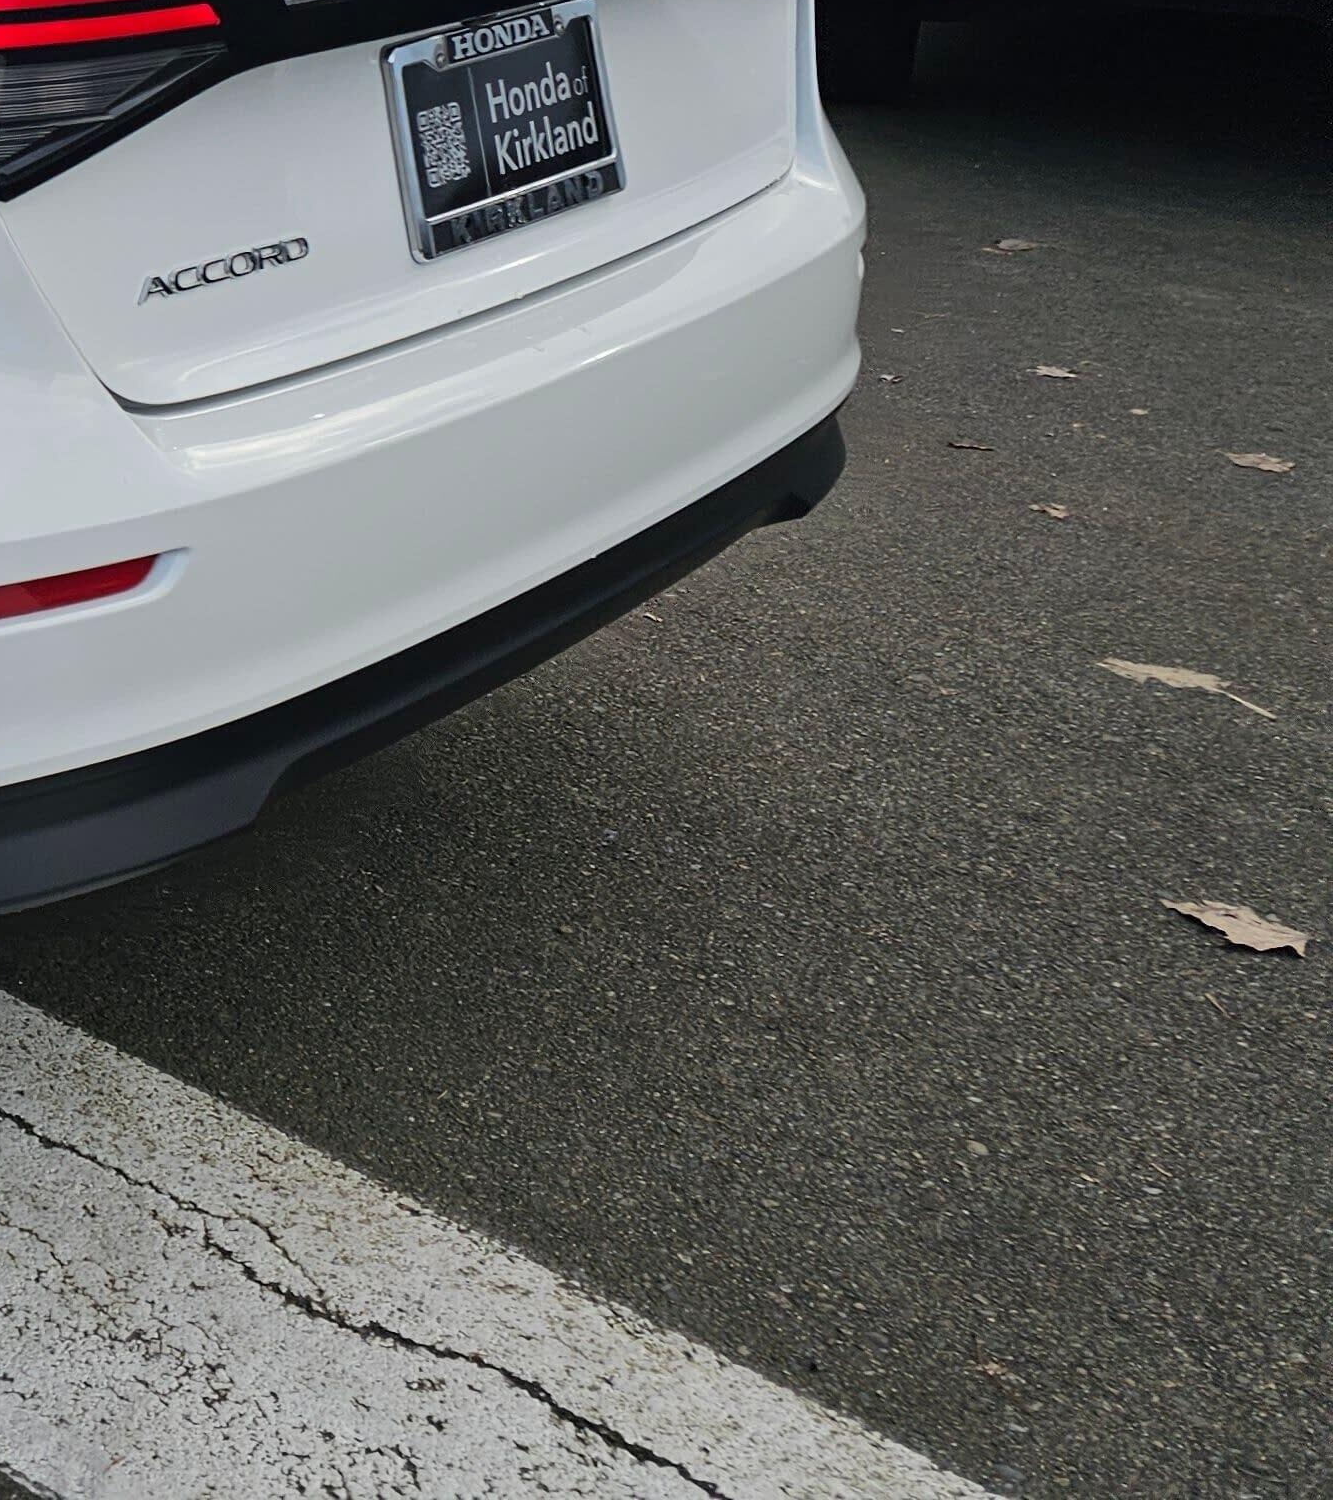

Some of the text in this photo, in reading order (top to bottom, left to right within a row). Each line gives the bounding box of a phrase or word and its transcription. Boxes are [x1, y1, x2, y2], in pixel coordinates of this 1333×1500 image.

[452, 15, 550, 60] HONDA
[485, 62, 589, 123] Honda of
[495, 102, 598, 175] Kirkland
[450, 171, 604, 243] KIRKLAND
[137, 237, 310, 305] ACCORD
